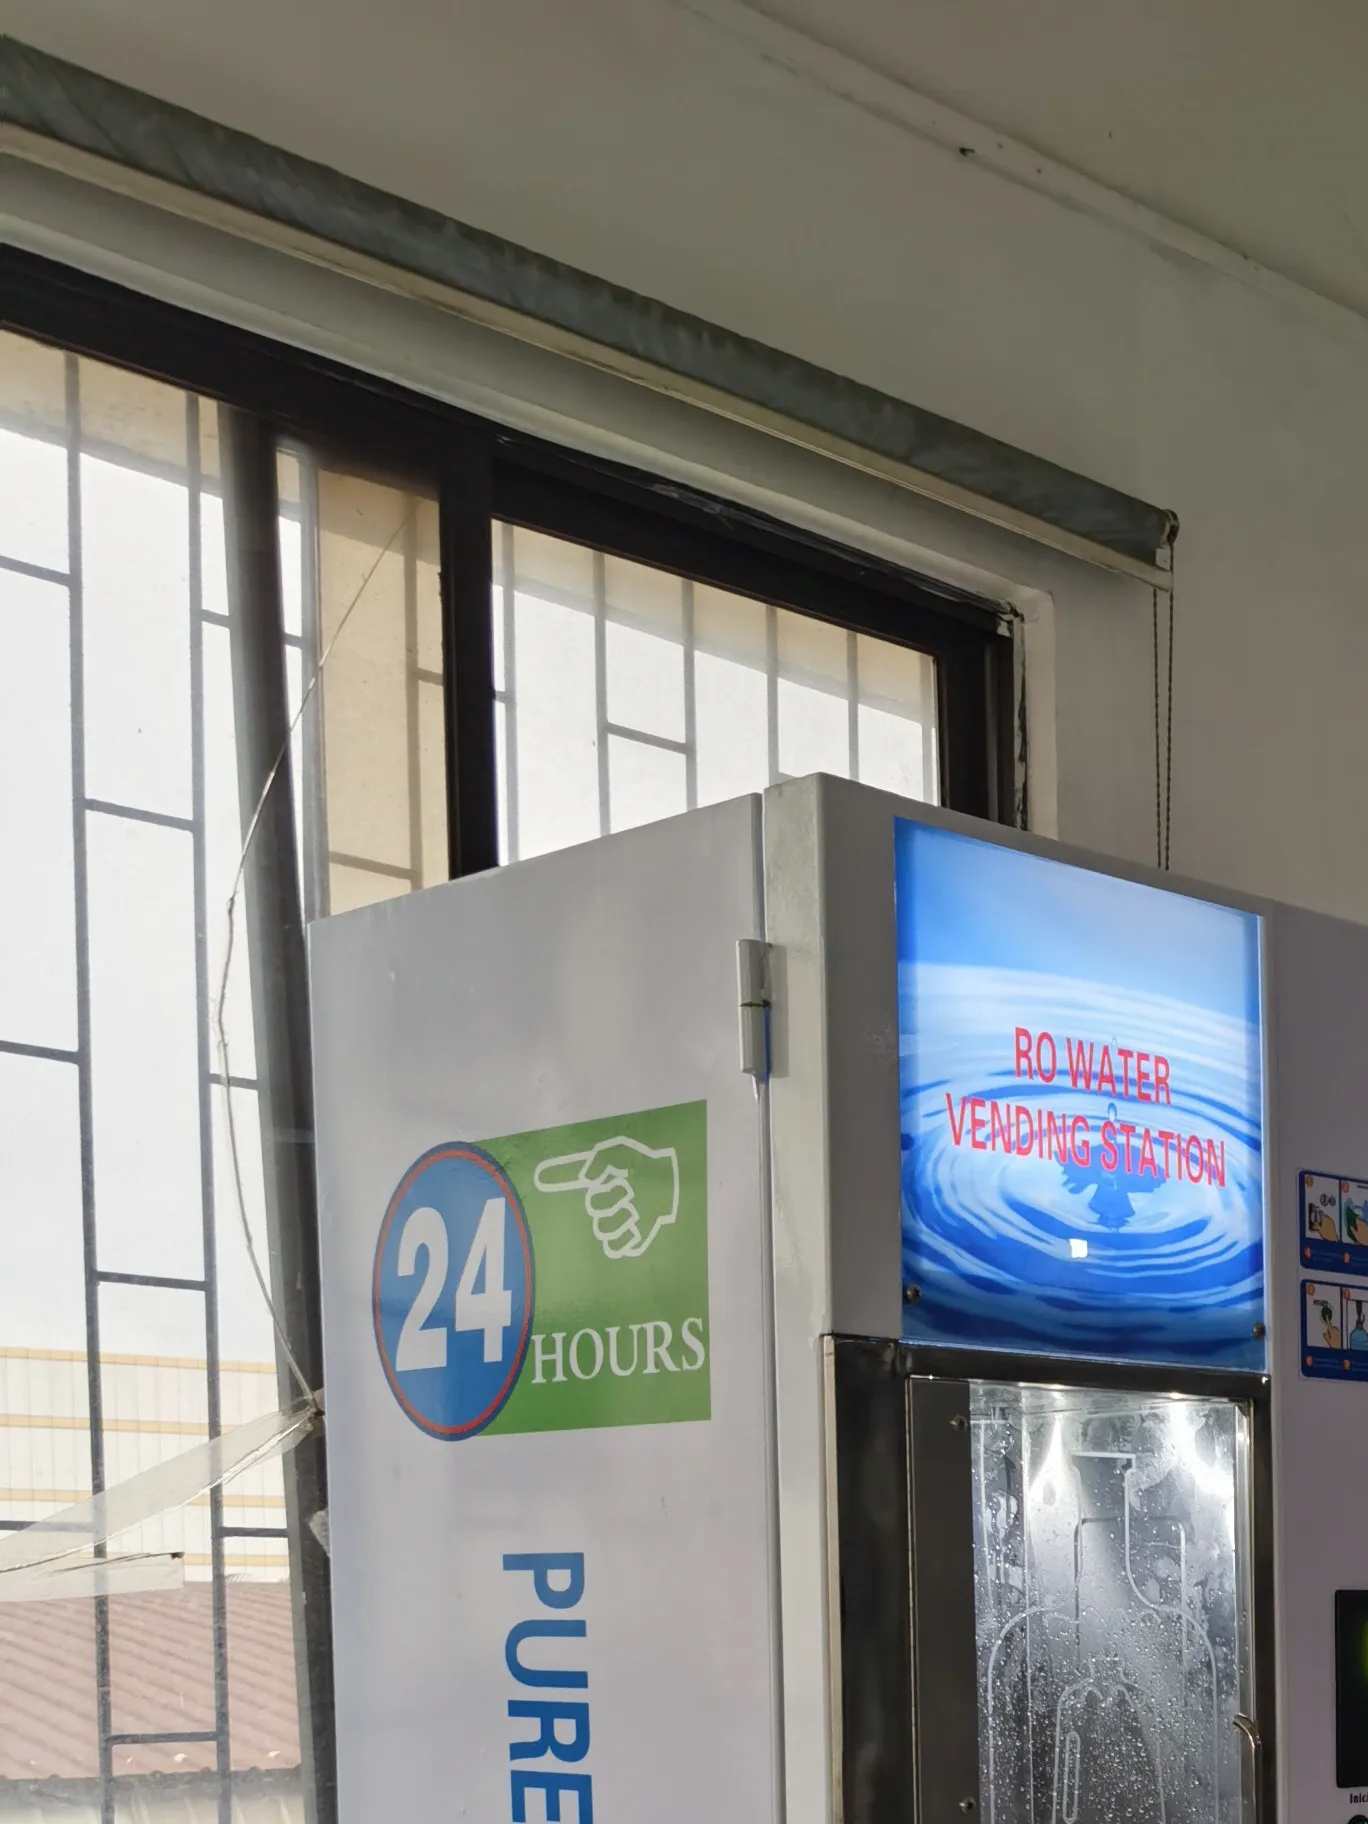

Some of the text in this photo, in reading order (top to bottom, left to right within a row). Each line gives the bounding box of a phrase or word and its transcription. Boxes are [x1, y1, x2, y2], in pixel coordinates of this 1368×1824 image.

[1014, 1026, 1171, 1105] RO WATER
[945, 1092, 1225, 1188] VENDING STATION
[395, 1197, 512, 1372] 24
[531, 1316, 705, 1384] HOURS
